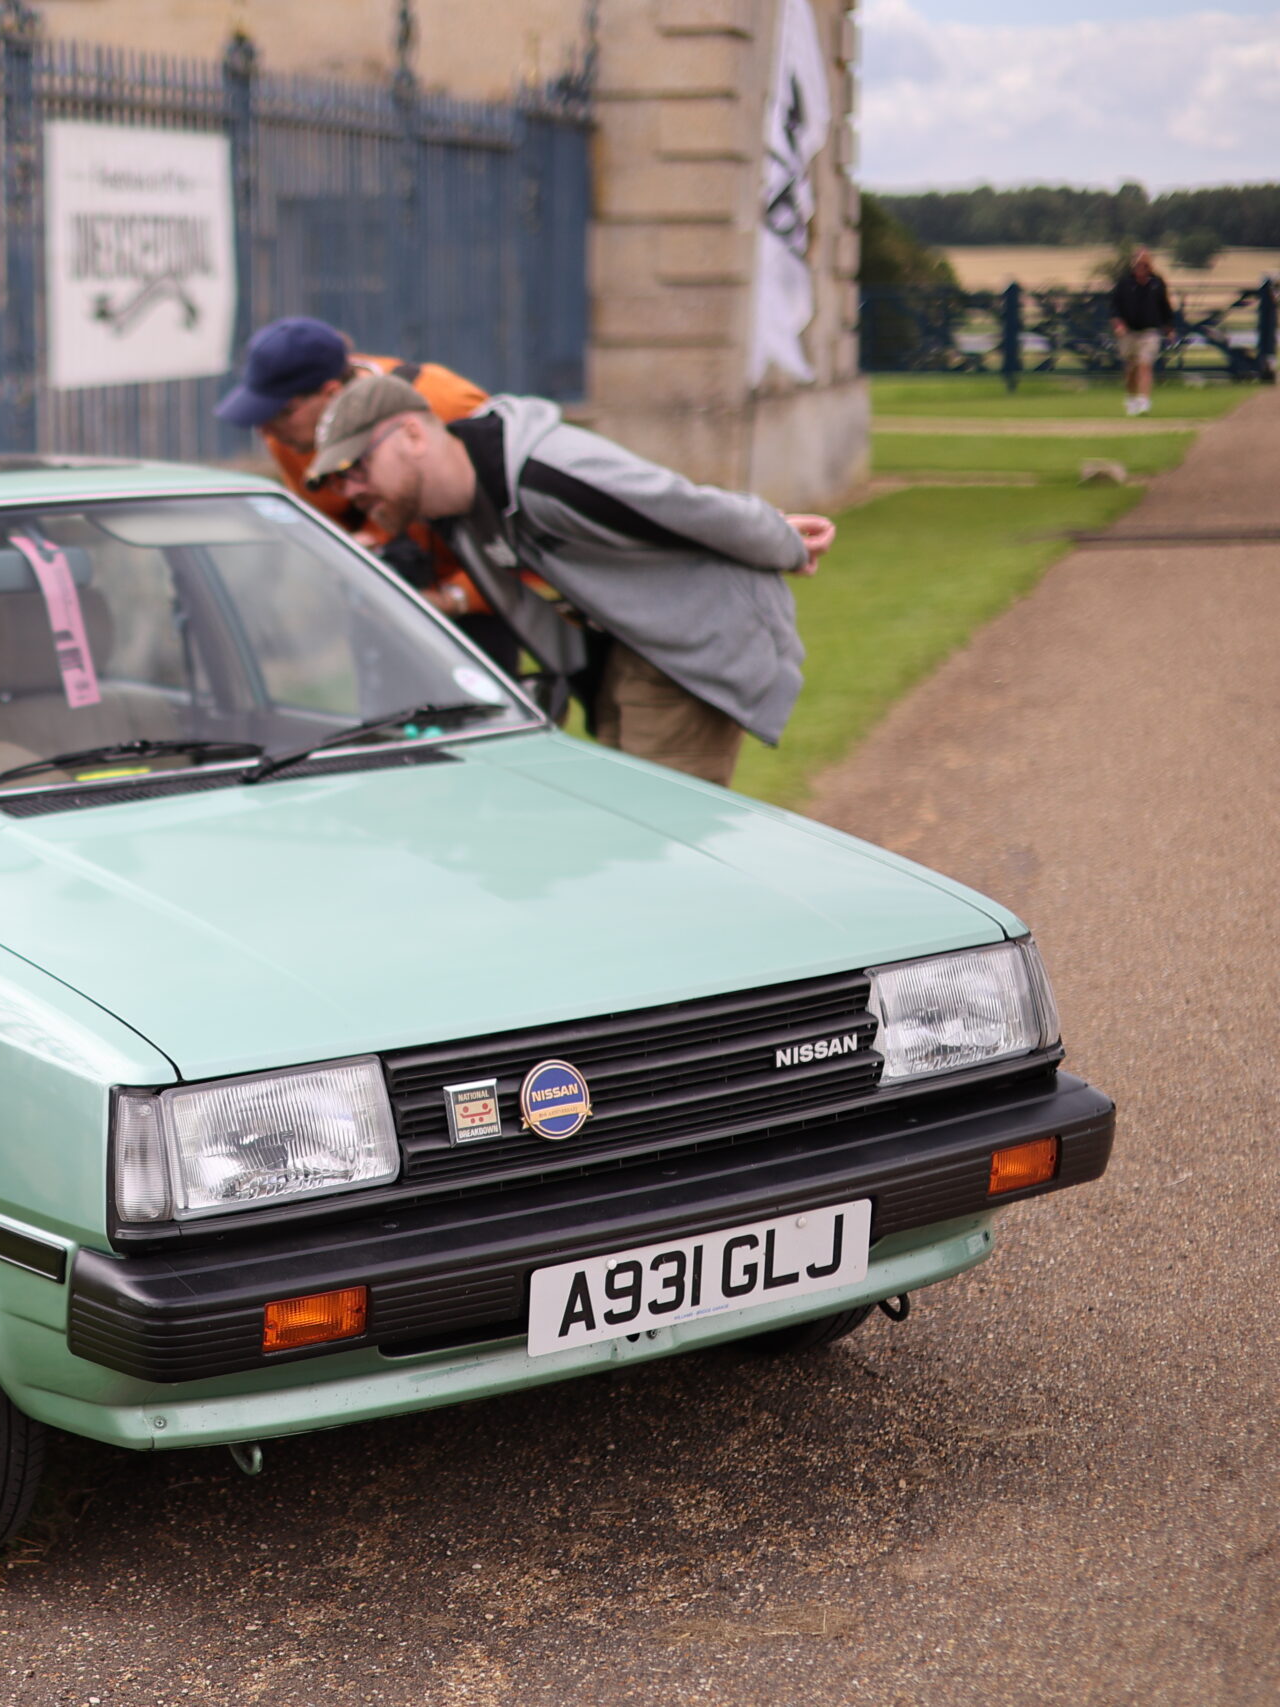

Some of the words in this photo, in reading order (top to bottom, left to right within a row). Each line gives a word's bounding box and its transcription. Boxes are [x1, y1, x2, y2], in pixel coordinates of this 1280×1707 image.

[776, 1033, 857, 1068] NISSAN
[458, 1089, 489, 1102] NATIONAL
[531, 1083, 579, 1102] NISSAN
[458, 1124, 499, 1139] BREAKDOWN
[558, 1244, 703, 1337] A931
[721, 1213, 844, 1298] GLJ
